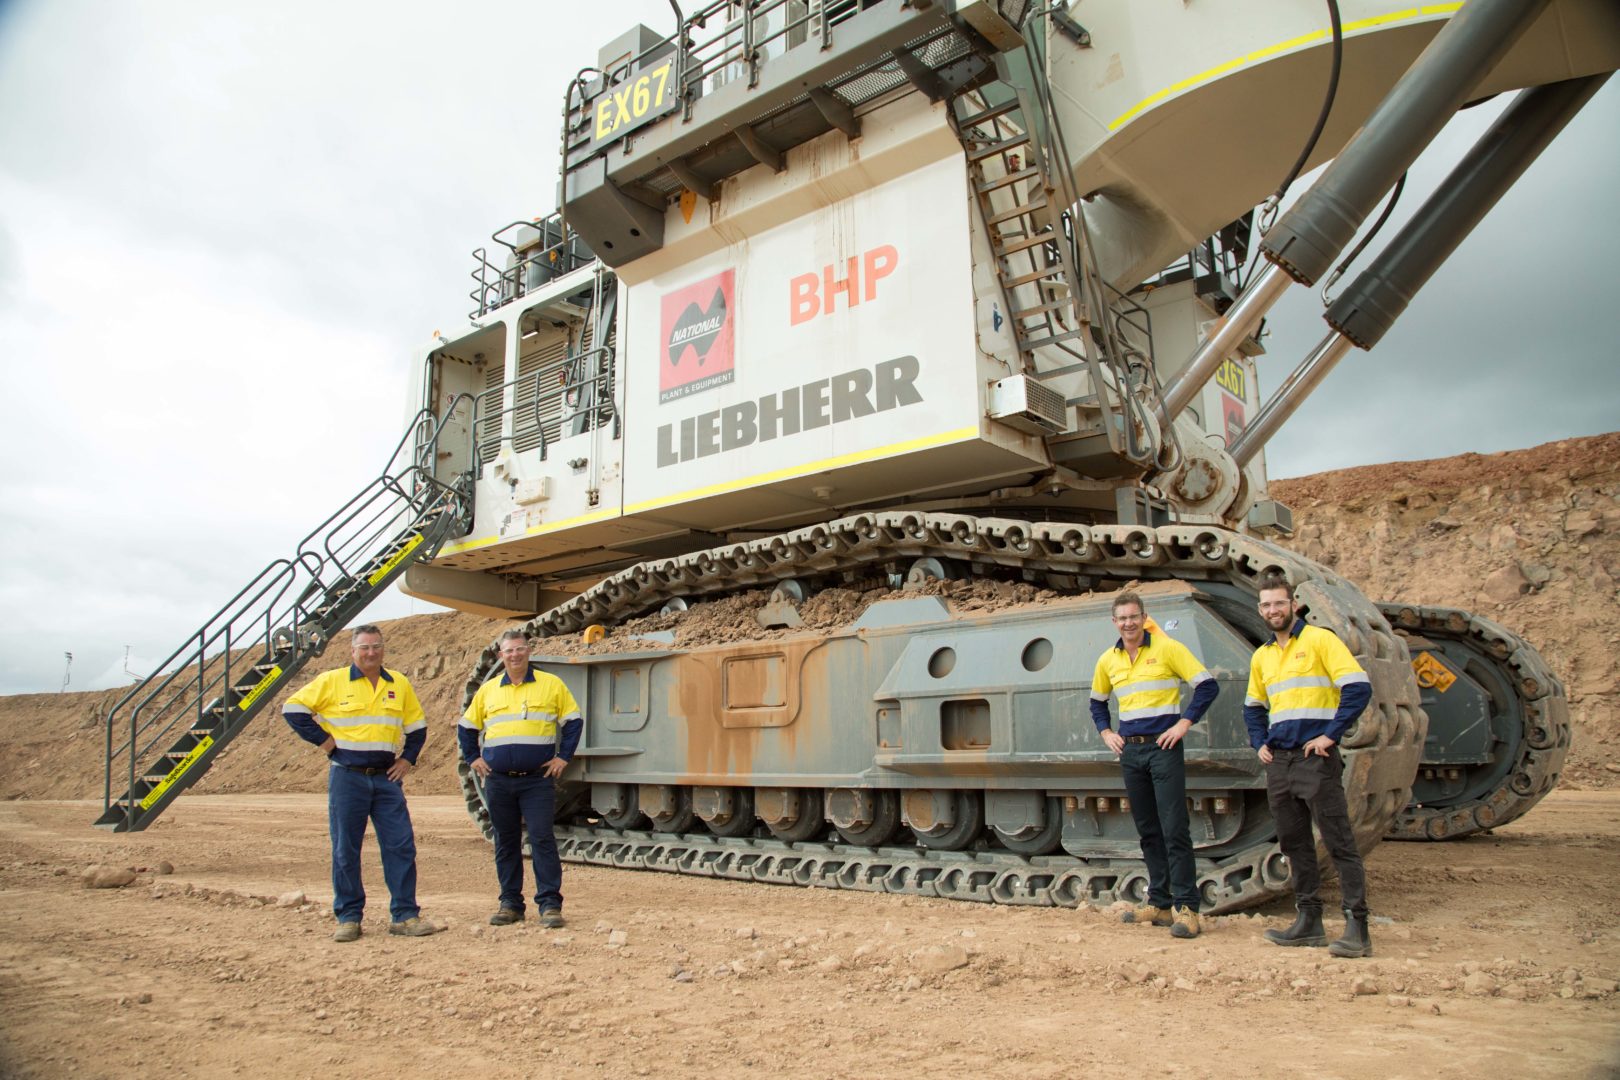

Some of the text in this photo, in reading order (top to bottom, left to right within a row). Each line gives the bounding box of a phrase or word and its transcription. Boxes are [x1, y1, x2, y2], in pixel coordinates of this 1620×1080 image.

[596, 63, 671, 141] EX67
[790, 243, 899, 327] BHP
[672, 315, 721, 343] NATIONAL
[661, 372, 732, 401] PLANT & EQUIPMENT
[1216, 359, 1244, 399] EX67
[657, 354, 925, 469] LIEBHERR
